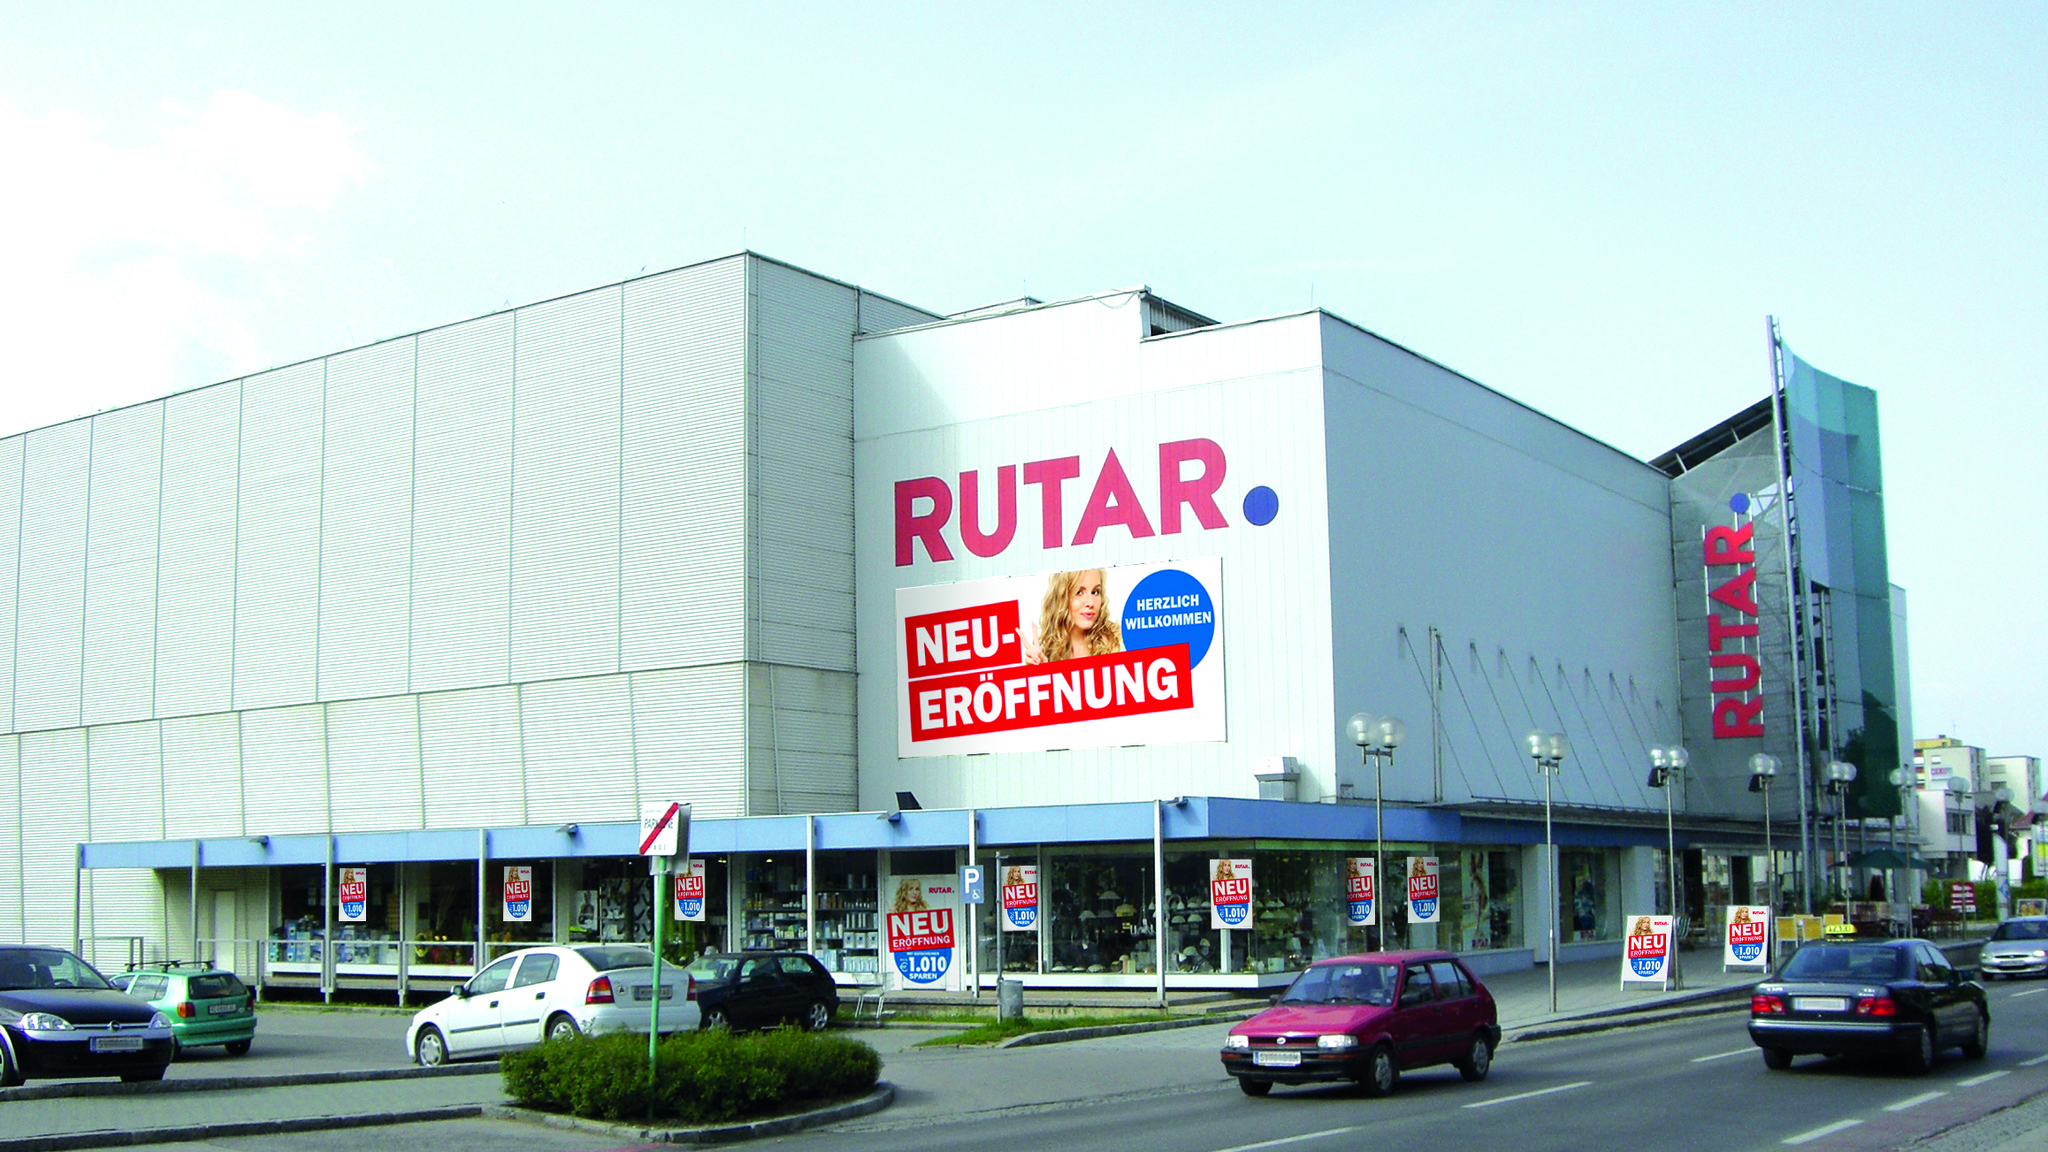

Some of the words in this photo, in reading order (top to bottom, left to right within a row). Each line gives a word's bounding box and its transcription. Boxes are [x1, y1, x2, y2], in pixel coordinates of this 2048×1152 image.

[1136, 593, 1200, 612] HERZLICH
[1125, 610, 1212, 631] WILLKOMMEN
[915, 614, 1015, 667] NEU-
[918, 656, 1179, 730] ERÖFFNUNG
[677, 877, 701, 891] NEU
[964, 868, 980, 894] P
[1214, 879, 1247, 896] NEU
[1347, 877, 1370, 892] NEU
[1411, 875, 1436, 891] NEU
[342, 883, 363, 895] NEU
[506, 882, 528, 895] NEU
[1005, 884, 1036, 900] NEU
[1224, 907, 1246, 918] 1.010
[1351, 905, 1370, 915] 1.010
[1418, 902, 1435, 912] 1.010
[1014, 911, 1034, 920] 1.010
[891, 910, 949, 937] NEU
[1731, 923, 1762, 937] NEU
[892, 935, 950, 948] ERÖFFNUNG
[1631, 935, 1663, 950] NEU
[1739, 946, 1760, 955] 1.010
[908, 956, 947, 972] 1.010
[1638, 961, 1660, 970] 1.010
[909, 972, 937, 980] SPAREN
